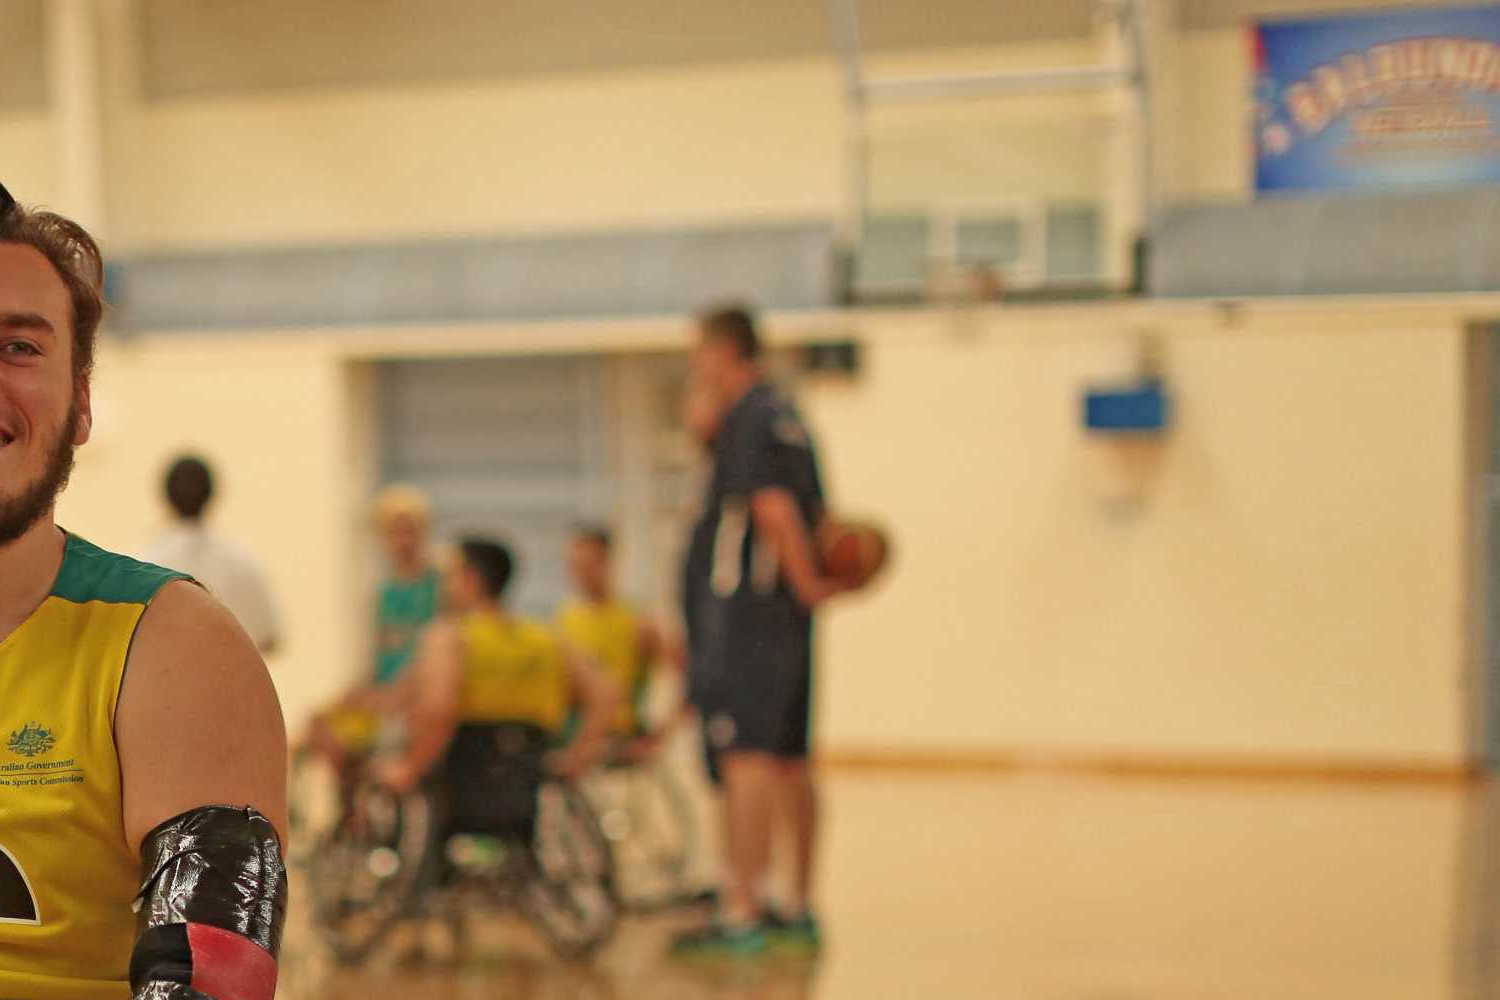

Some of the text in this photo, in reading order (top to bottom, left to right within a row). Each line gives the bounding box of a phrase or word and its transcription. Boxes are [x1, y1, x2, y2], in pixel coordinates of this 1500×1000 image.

[26, 759, 75, 770] Government
[12, 778, 38, 788] Sports
[40, 774, 84, 786] Commission
